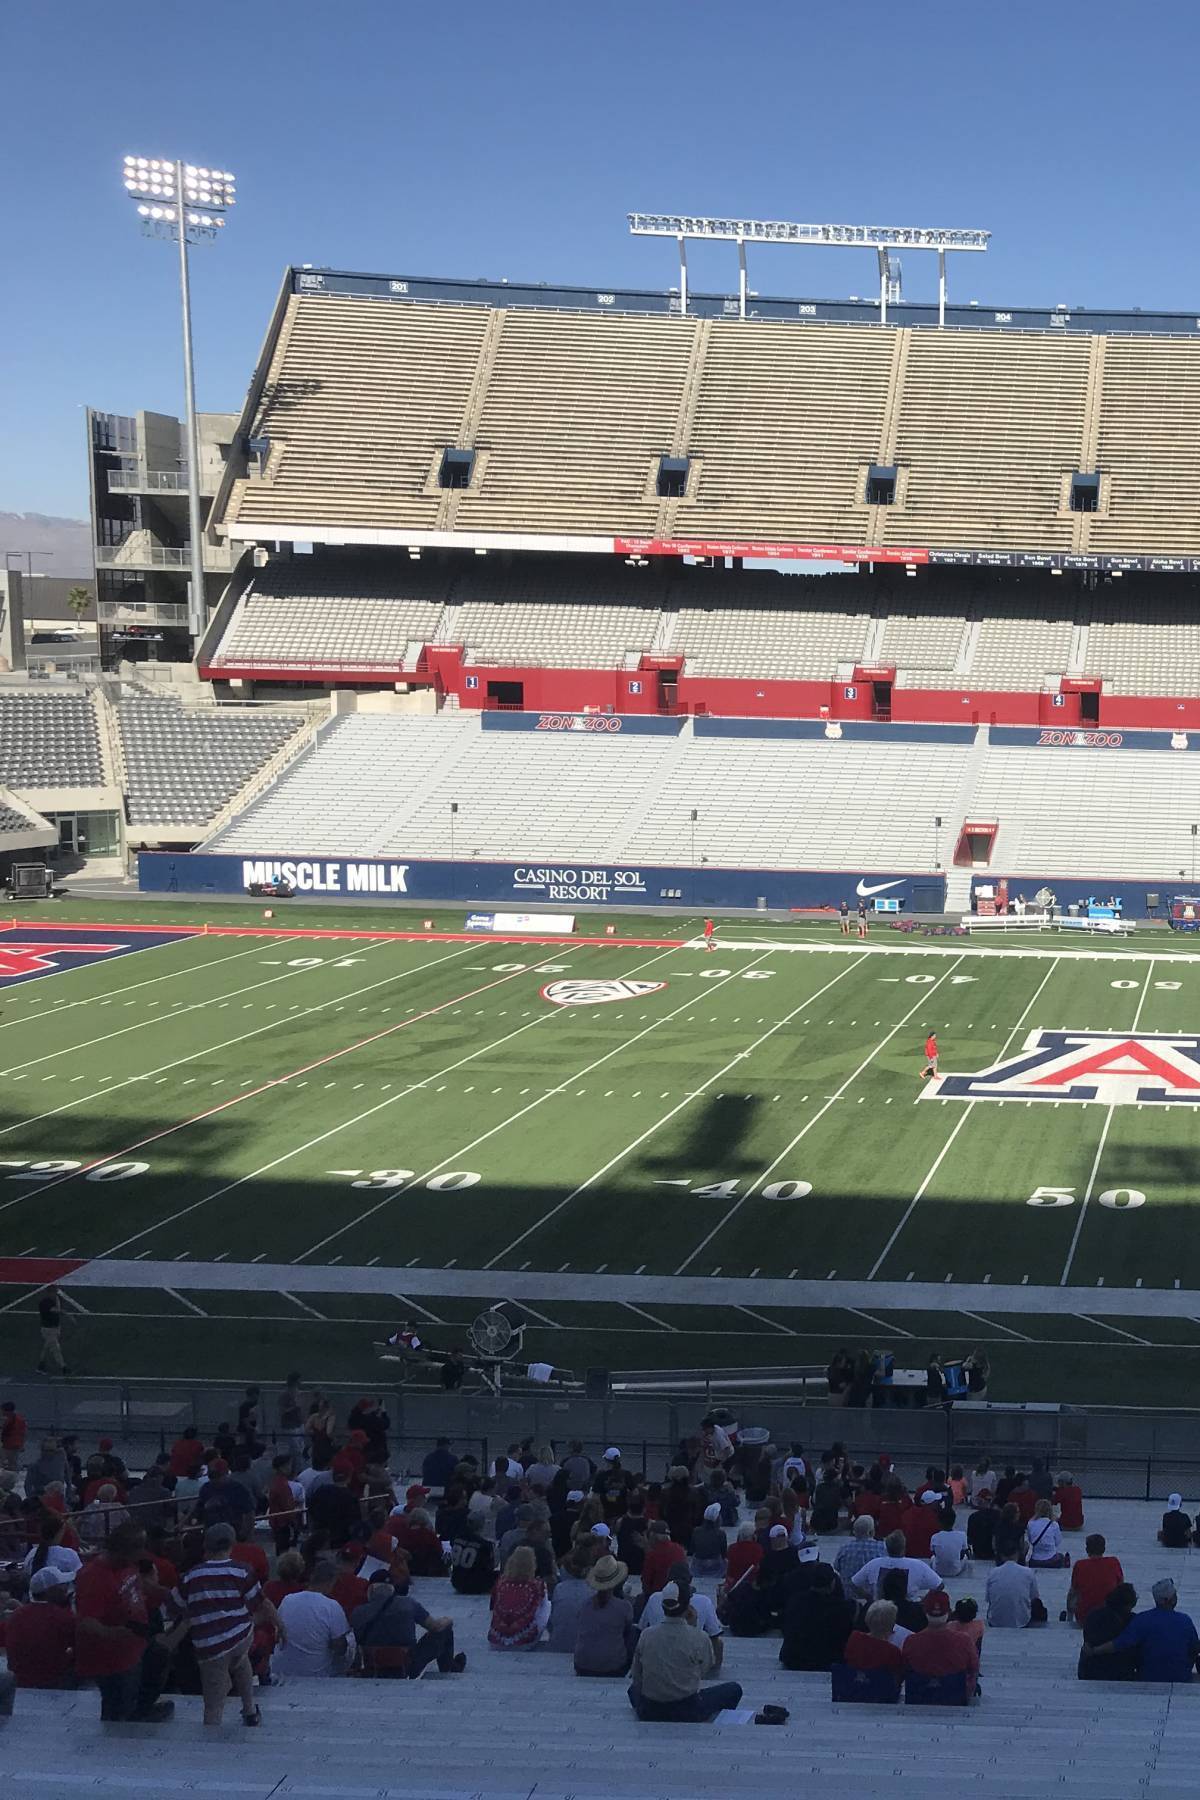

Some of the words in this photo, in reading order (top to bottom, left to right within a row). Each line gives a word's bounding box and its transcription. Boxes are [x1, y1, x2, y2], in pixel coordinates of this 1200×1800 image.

[392, 282, 408, 291] 201
[598, 294, 615, 303] 202
[243, 861, 341, 891] MUSCLE
[347, 864, 410, 892] MILK
[514, 868, 577, 884] CASINO
[581, 870, 612, 885] DEL
[614, 871, 645, 886] SOL
[549, 885, 611, 901] RESORT
